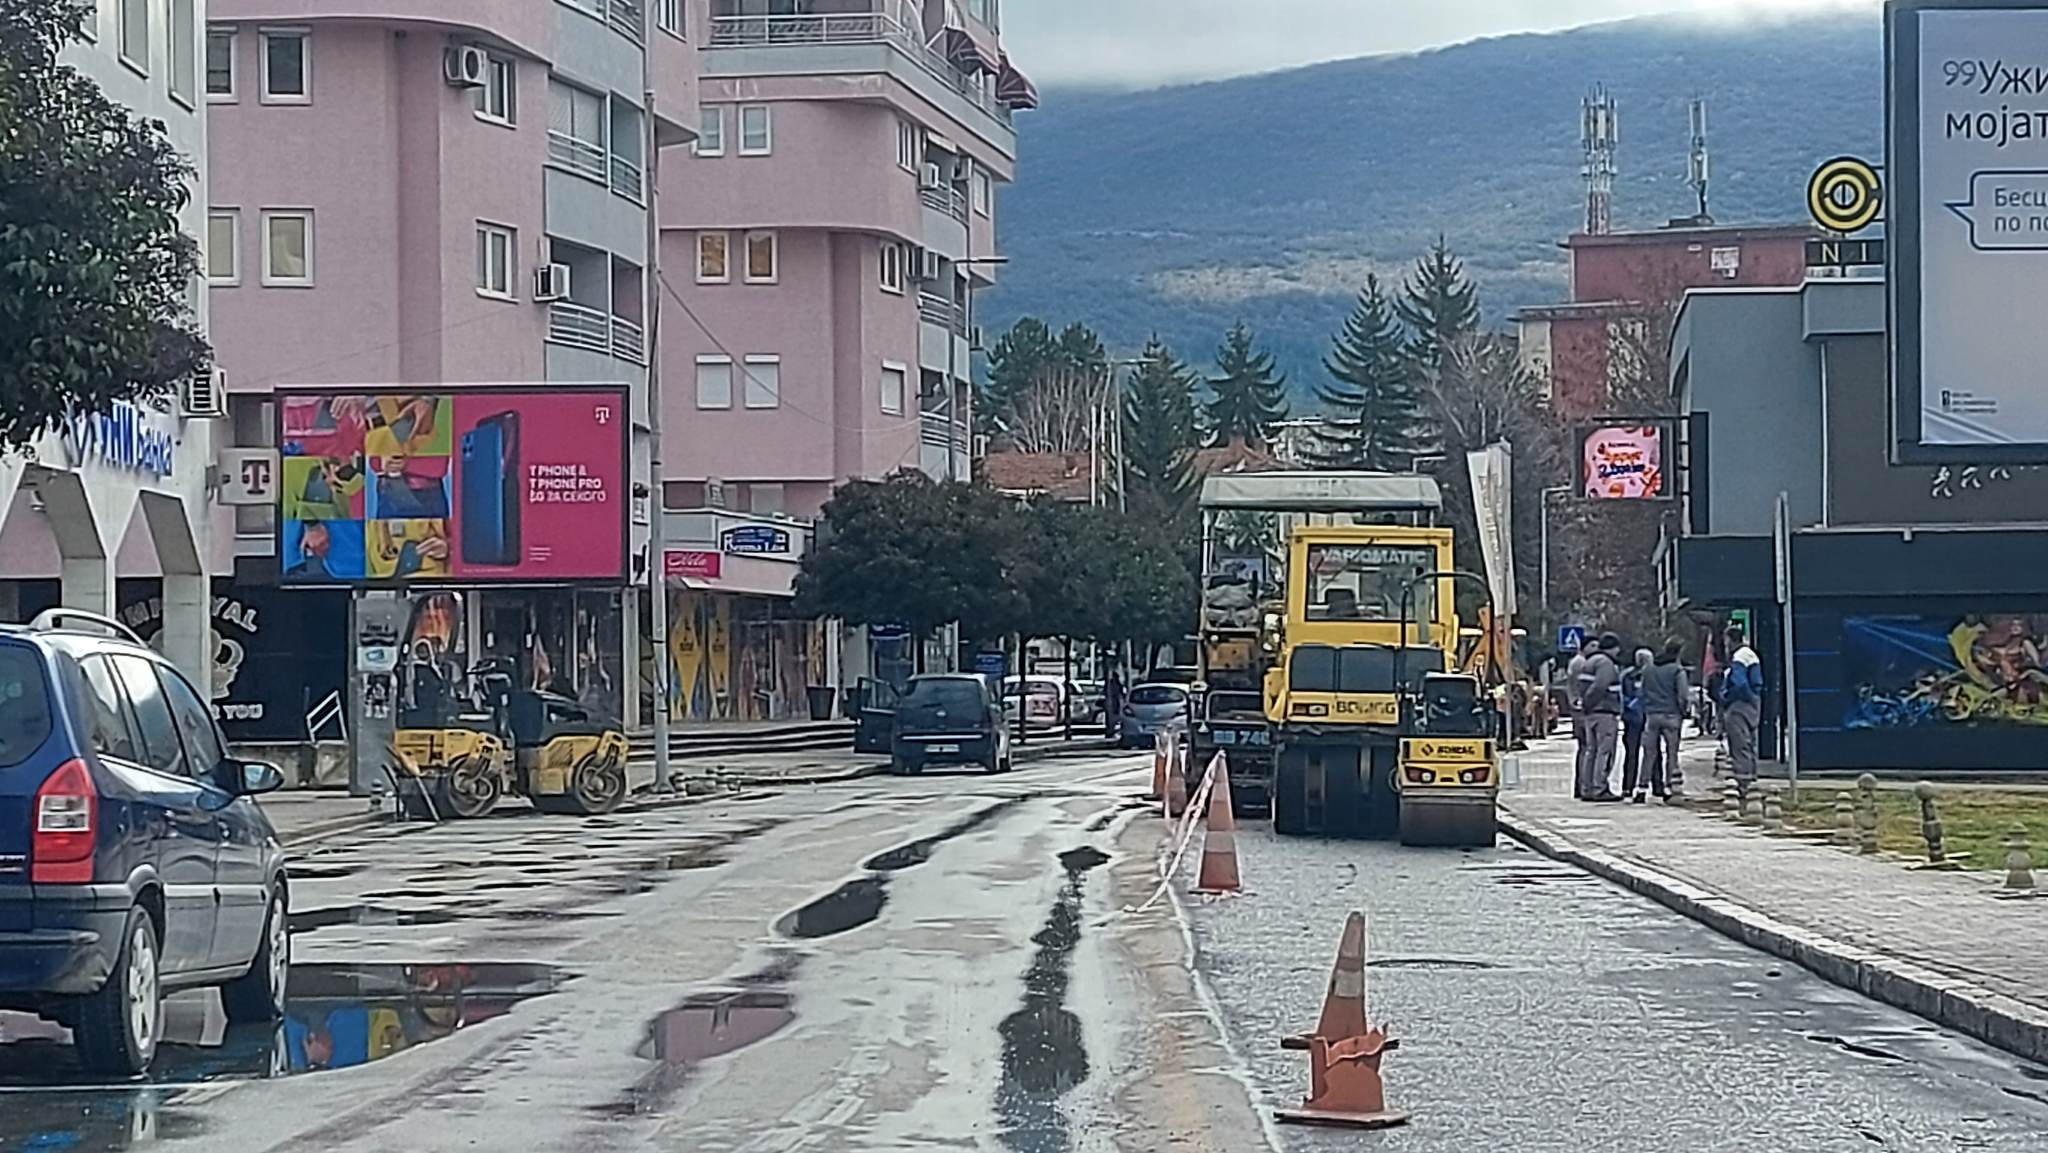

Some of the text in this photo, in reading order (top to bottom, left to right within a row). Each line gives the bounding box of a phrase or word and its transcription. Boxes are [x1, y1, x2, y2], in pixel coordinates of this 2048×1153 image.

[1994, 216, 2021, 232] по
[538, 464, 577, 477] PHONE
[538, 477, 577, 490] PHONE
[578, 477, 602, 489] PRO
[222, 703, 263, 720] YOU
